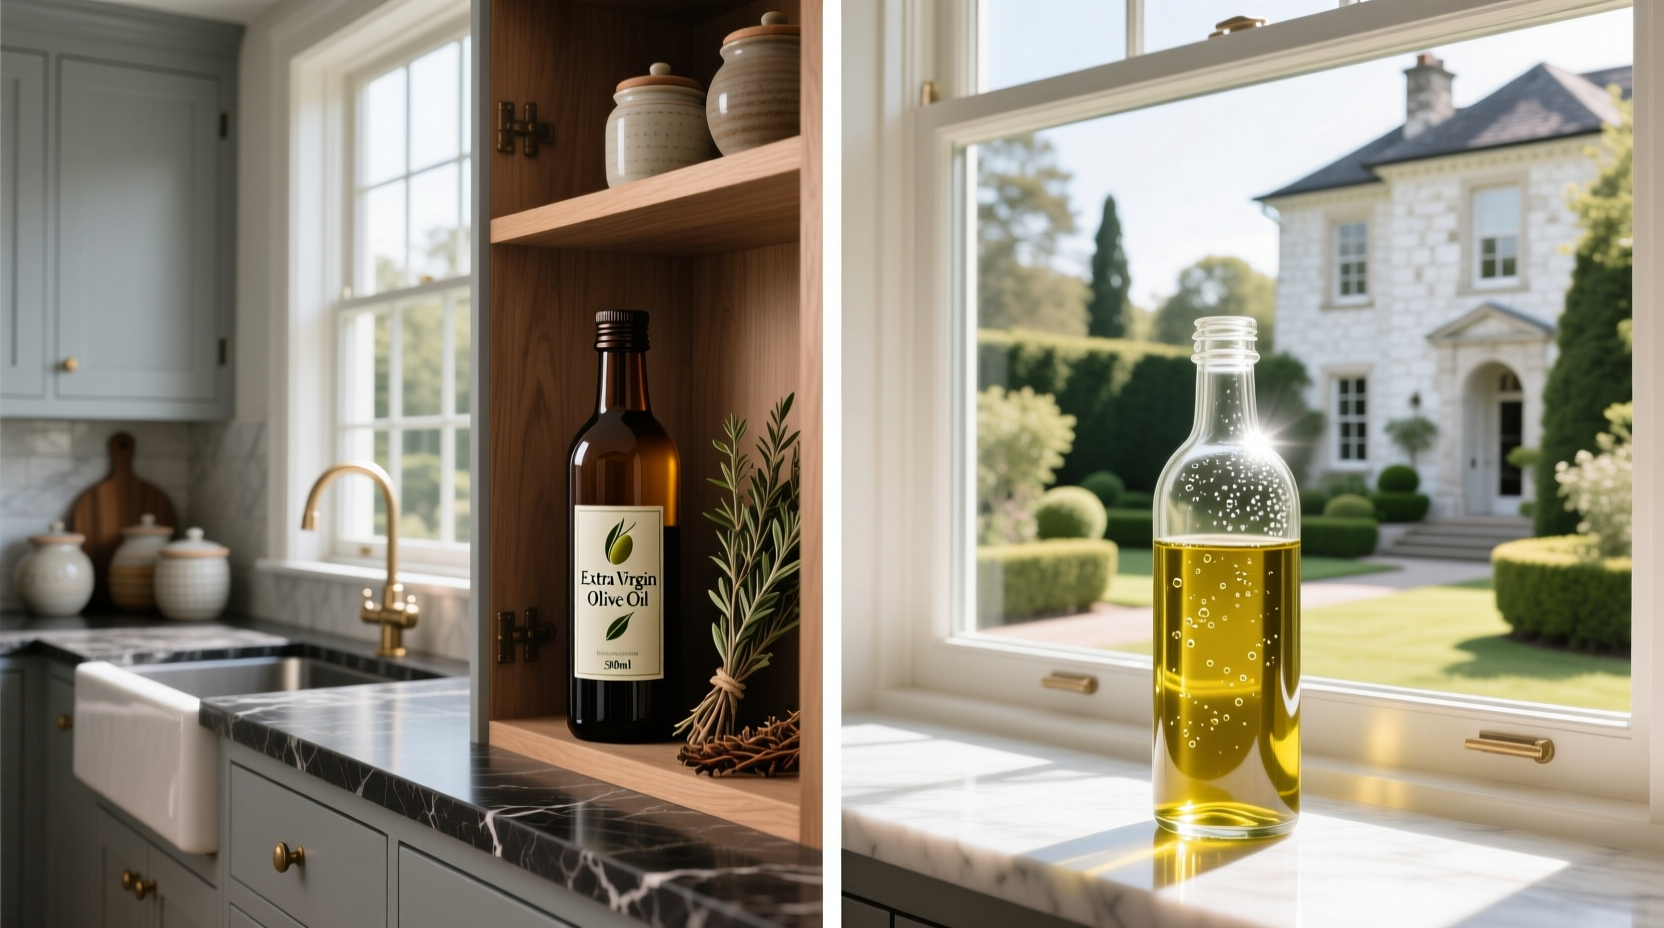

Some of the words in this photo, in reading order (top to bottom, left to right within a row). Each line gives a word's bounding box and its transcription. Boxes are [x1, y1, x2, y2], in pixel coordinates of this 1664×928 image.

[581, 570, 615, 586] Extra
[616, 571, 657, 590] Virgin
[587, 590, 624, 607] Olive
[626, 590, 649, 607] Oil
